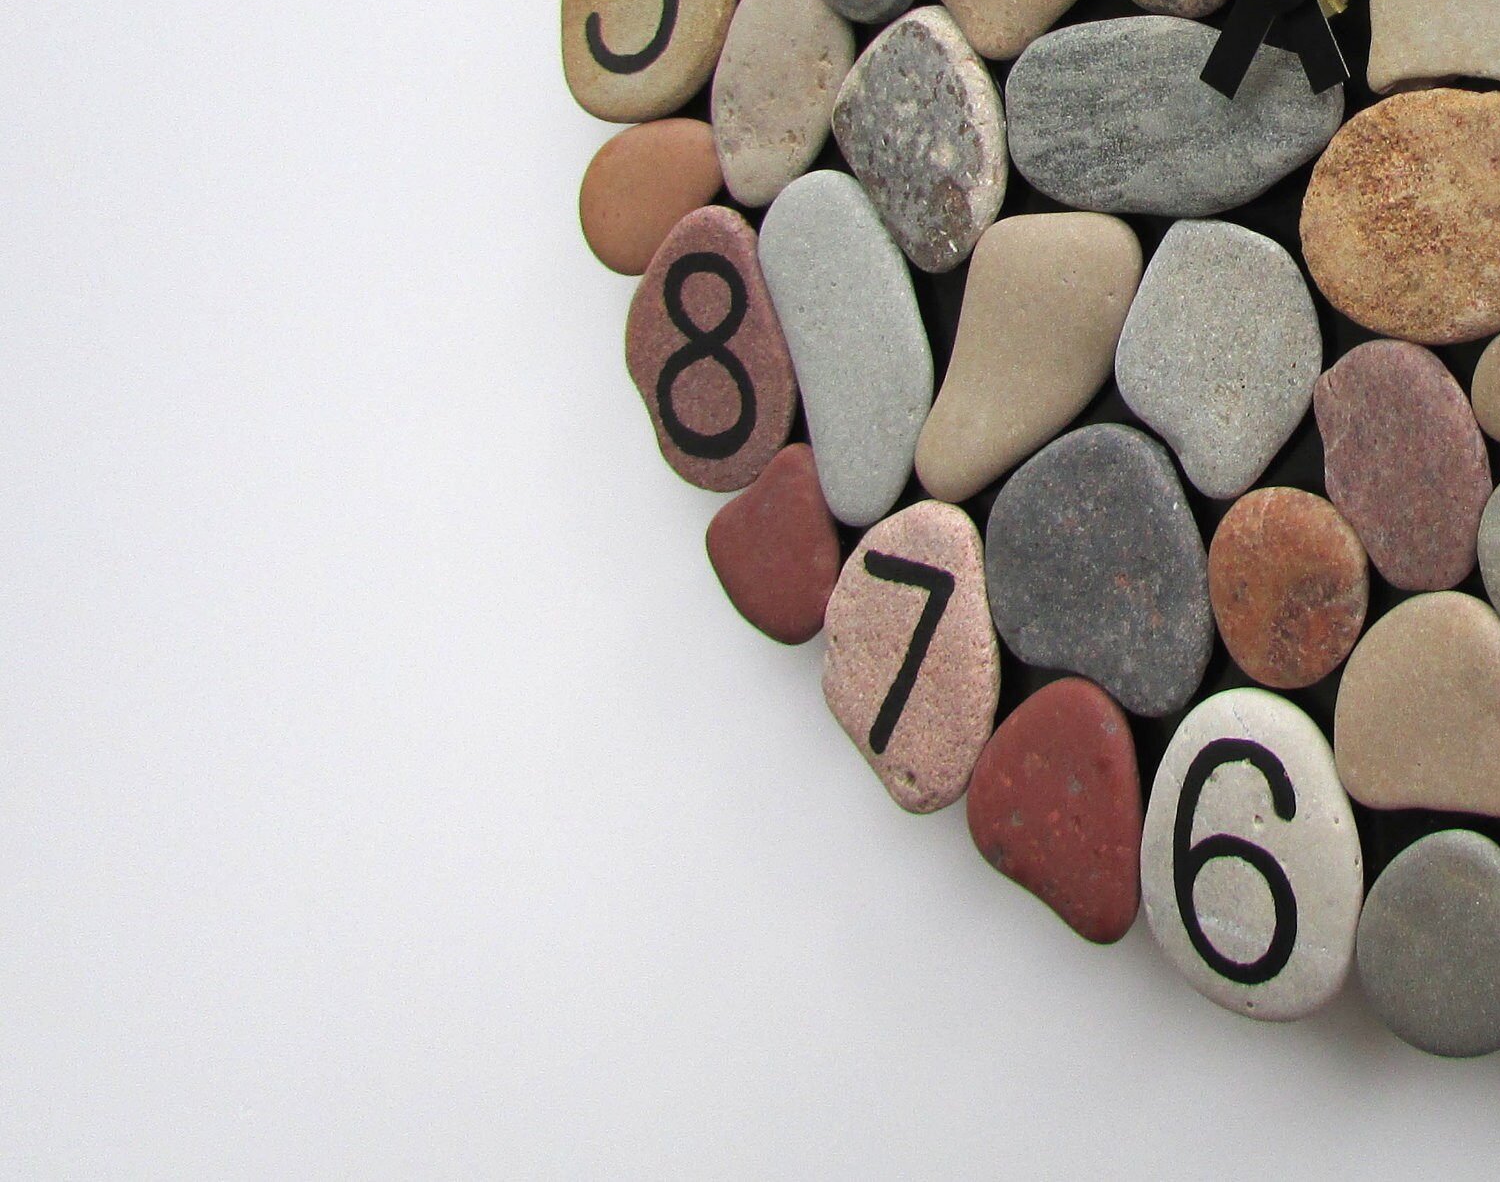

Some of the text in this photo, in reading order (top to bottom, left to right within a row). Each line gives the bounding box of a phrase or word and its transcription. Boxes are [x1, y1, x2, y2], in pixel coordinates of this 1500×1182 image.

[657, 252, 757, 460] 8
[865, 551, 954, 754] 7
[1174, 740, 1297, 983] 6
